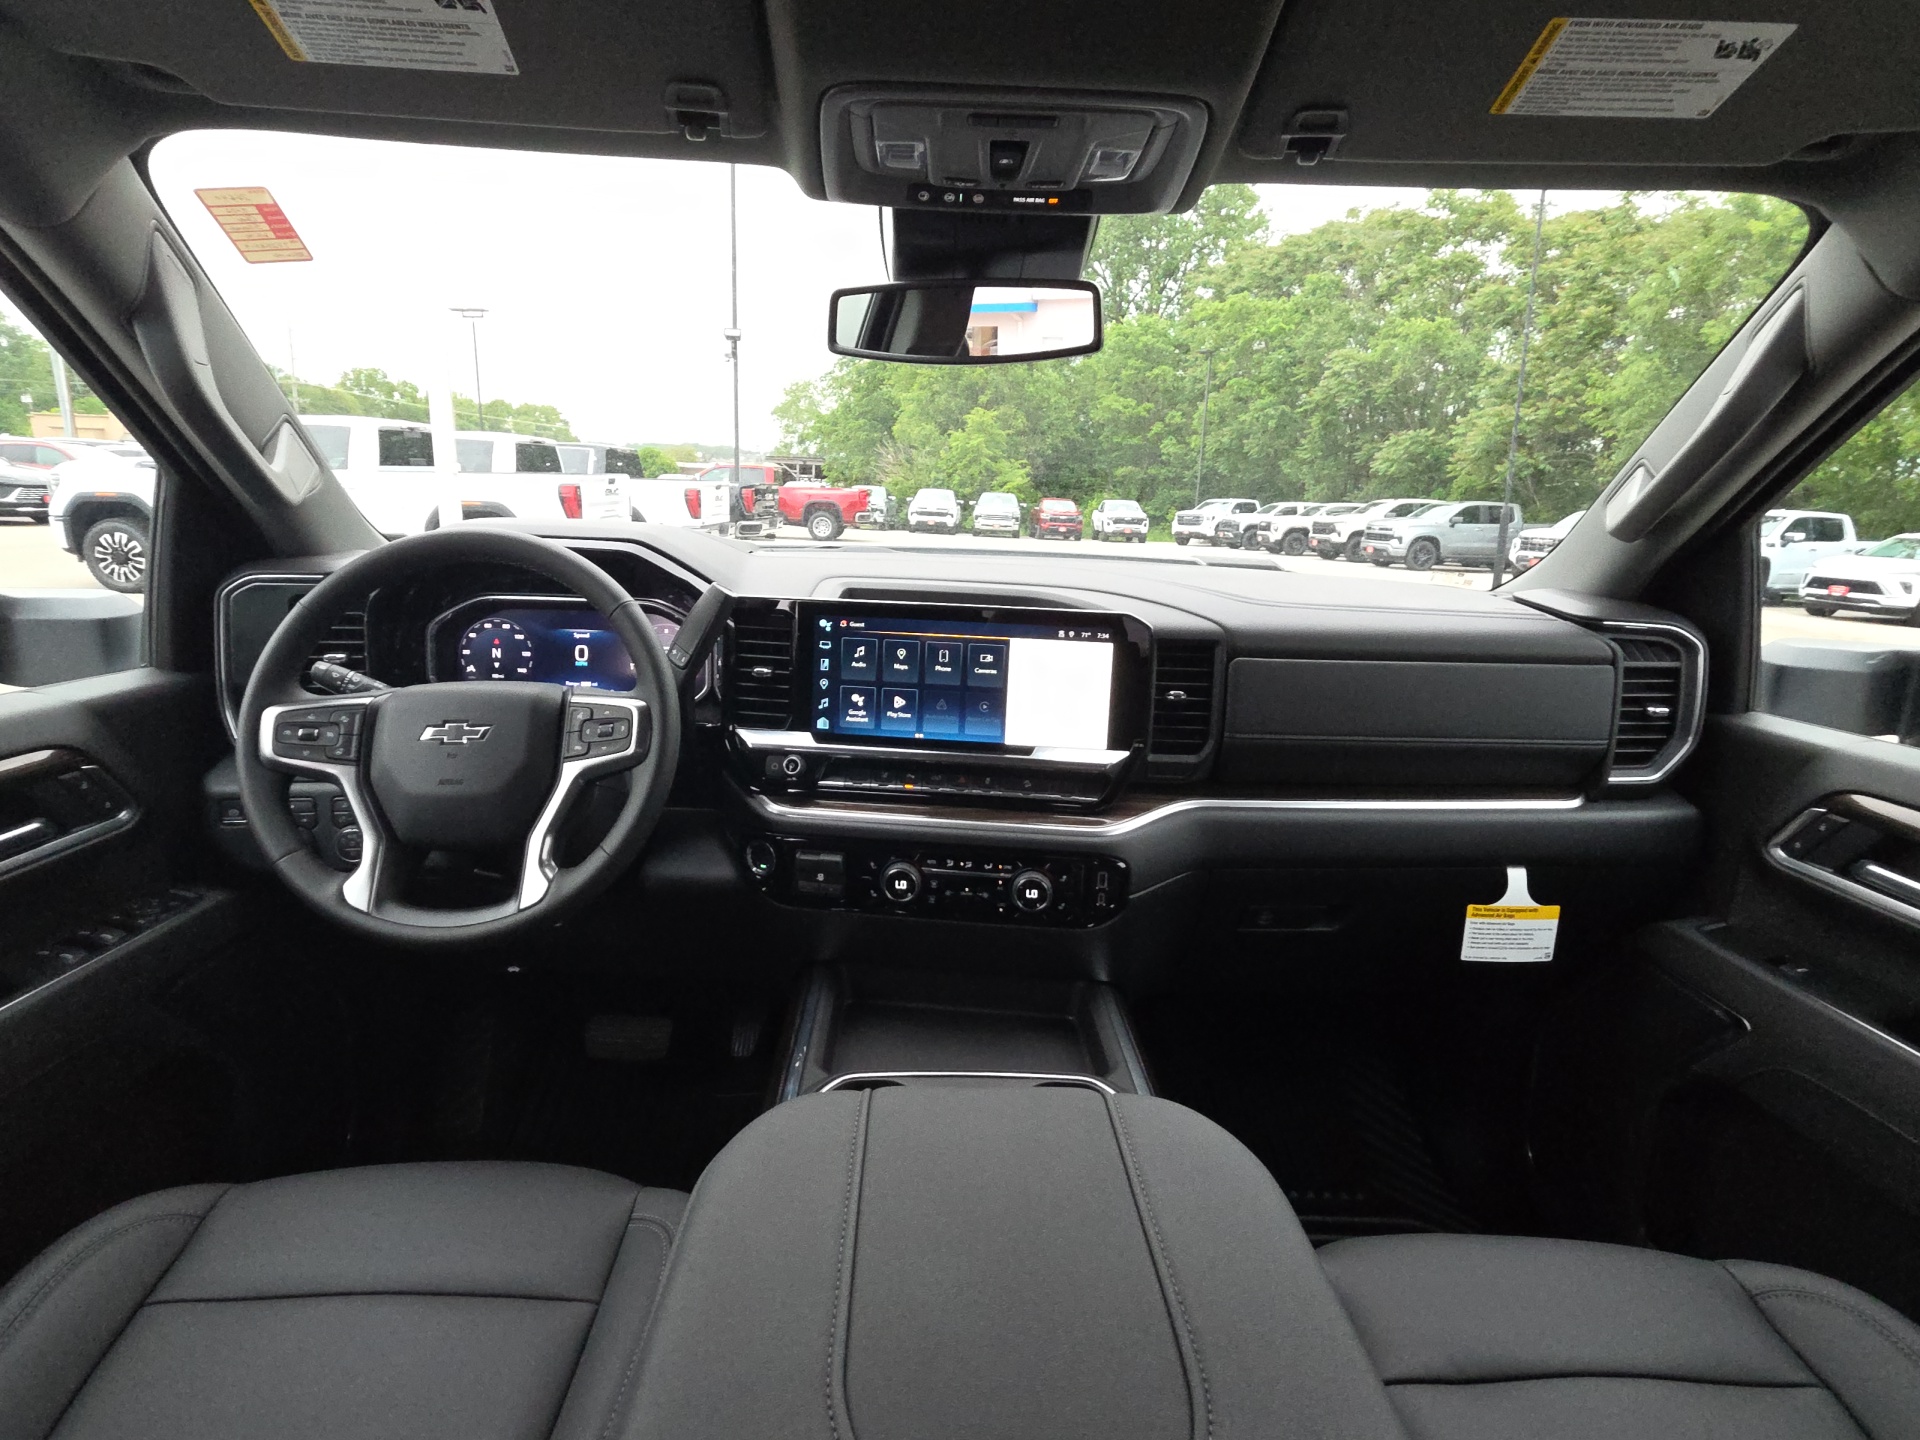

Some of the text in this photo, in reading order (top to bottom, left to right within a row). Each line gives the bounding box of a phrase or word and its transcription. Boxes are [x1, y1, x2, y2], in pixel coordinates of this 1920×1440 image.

[491, 648, 501, 658] N
[575, 644, 589, 661] 0
[974, 667, 998, 675] Cameras
